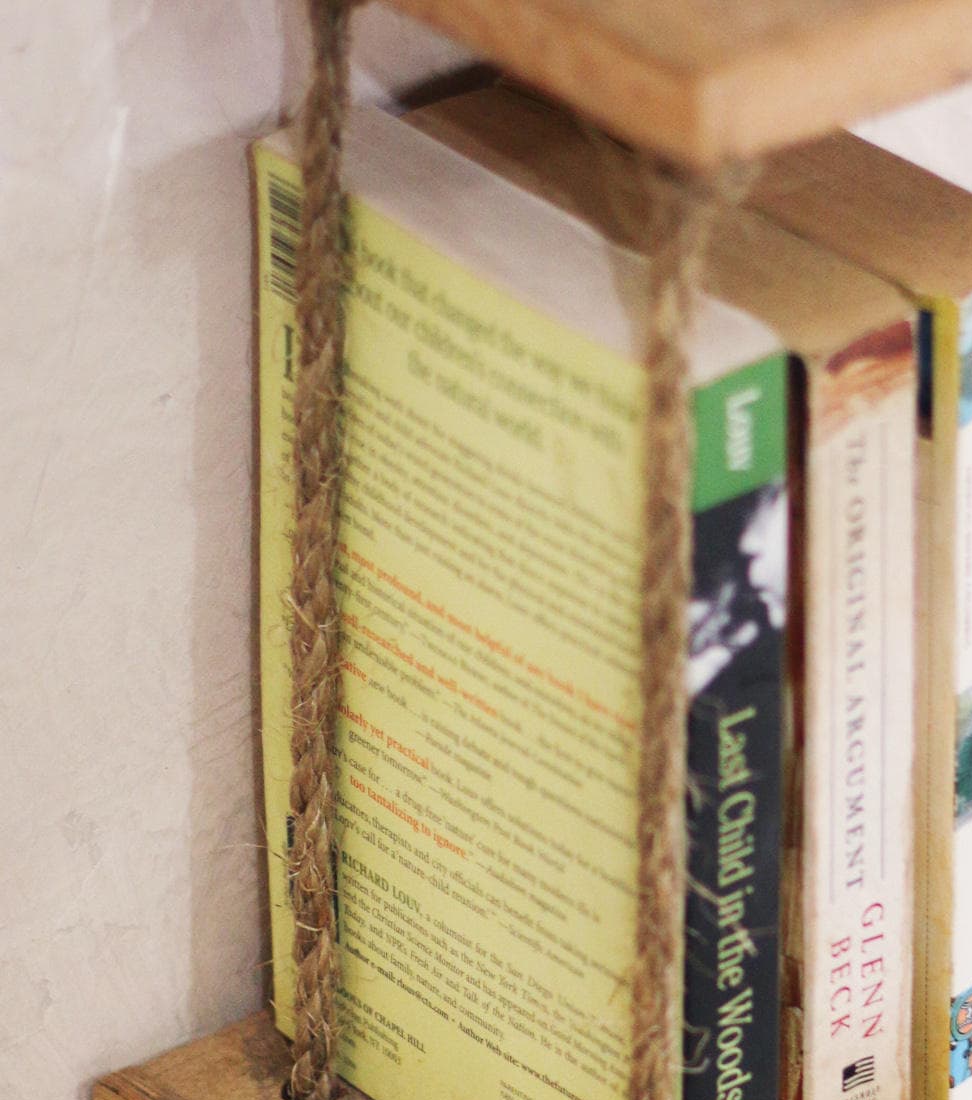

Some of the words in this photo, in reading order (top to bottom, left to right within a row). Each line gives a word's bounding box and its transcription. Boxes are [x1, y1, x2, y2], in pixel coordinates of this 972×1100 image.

[846, 497, 866, 682] ORIGINAL
[718, 706, 757, 792] Last
[367, 785, 418, 834] tantalizing
[844, 697, 866, 890] ARGUMENT
[340, 848, 388, 894] RICHARD
[717, 789, 757, 888] Child
[717, 888, 754, 934] in
[717, 929, 758, 992] the
[829, 935, 853, 1039] BECK
[861, 902, 885, 1040] GLENN
[458, 1017, 483, 1046] Author
